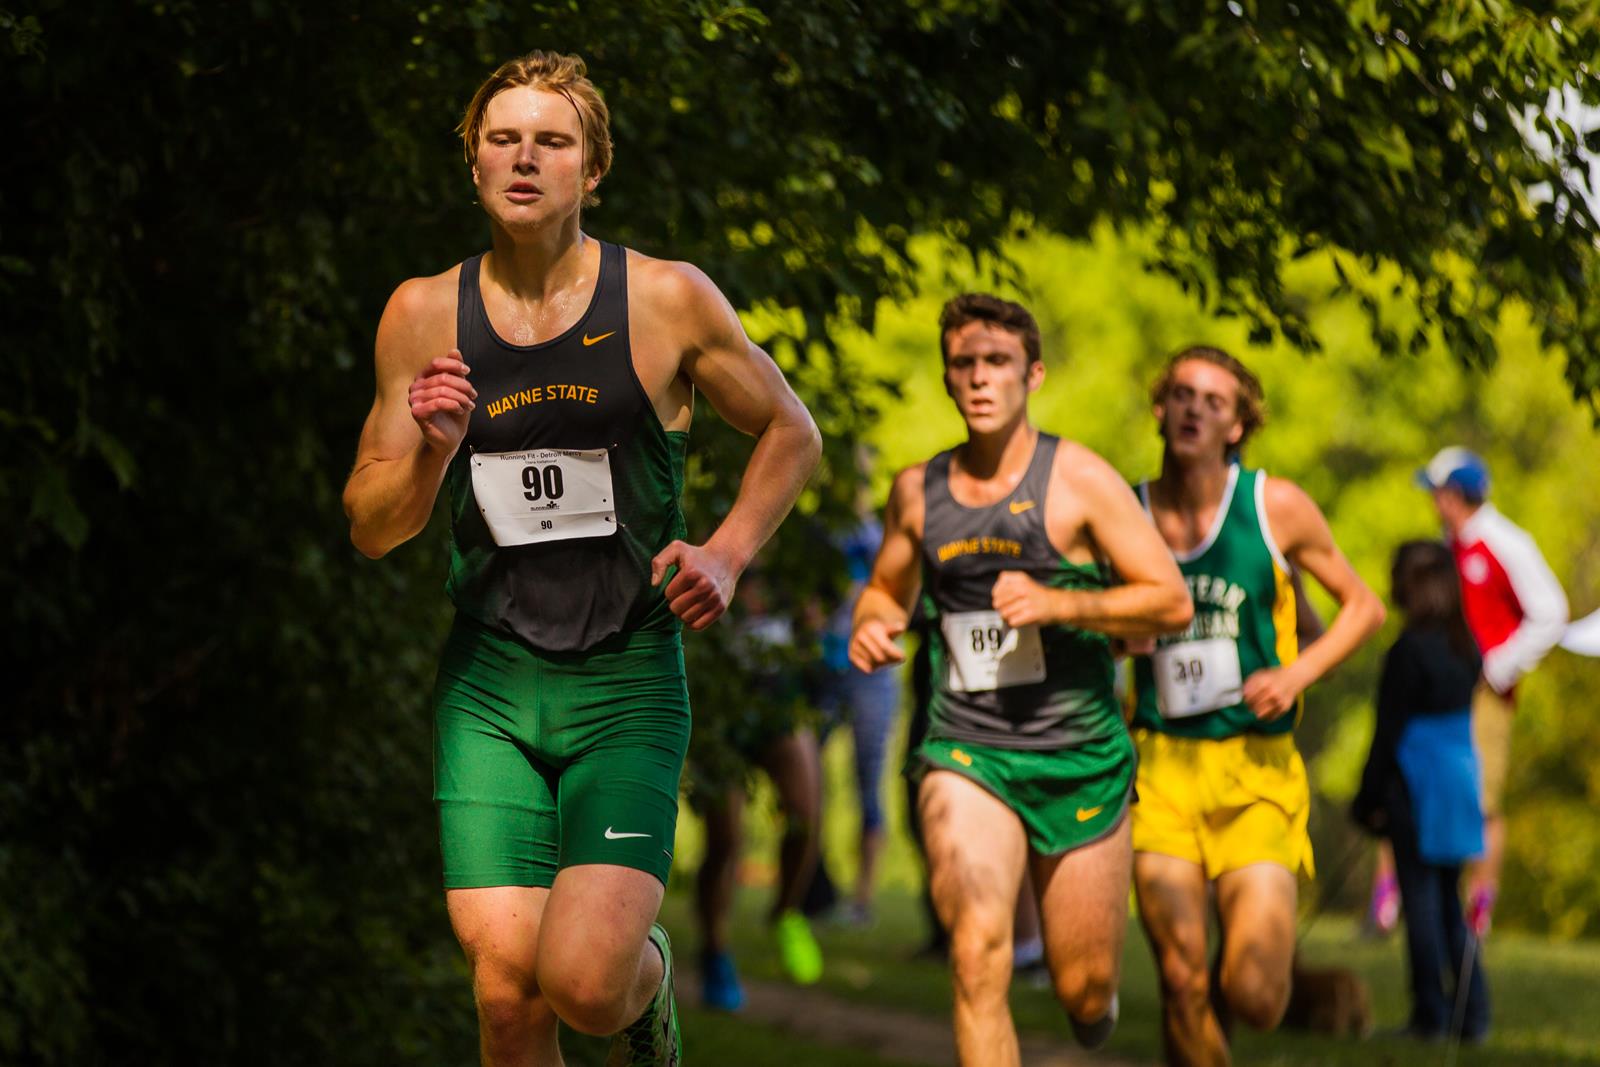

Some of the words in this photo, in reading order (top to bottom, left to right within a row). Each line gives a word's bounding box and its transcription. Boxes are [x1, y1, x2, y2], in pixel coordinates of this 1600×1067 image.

[487, 387, 543, 419] WAYNE
[546, 384, 599, 404] STATE
[500, 453, 526, 461] Running
[540, 451, 562, 459] Detroit
[521, 464, 564, 501] 90
[541, 520, 552, 529] 90
[971, 627, 1001, 653] 89
